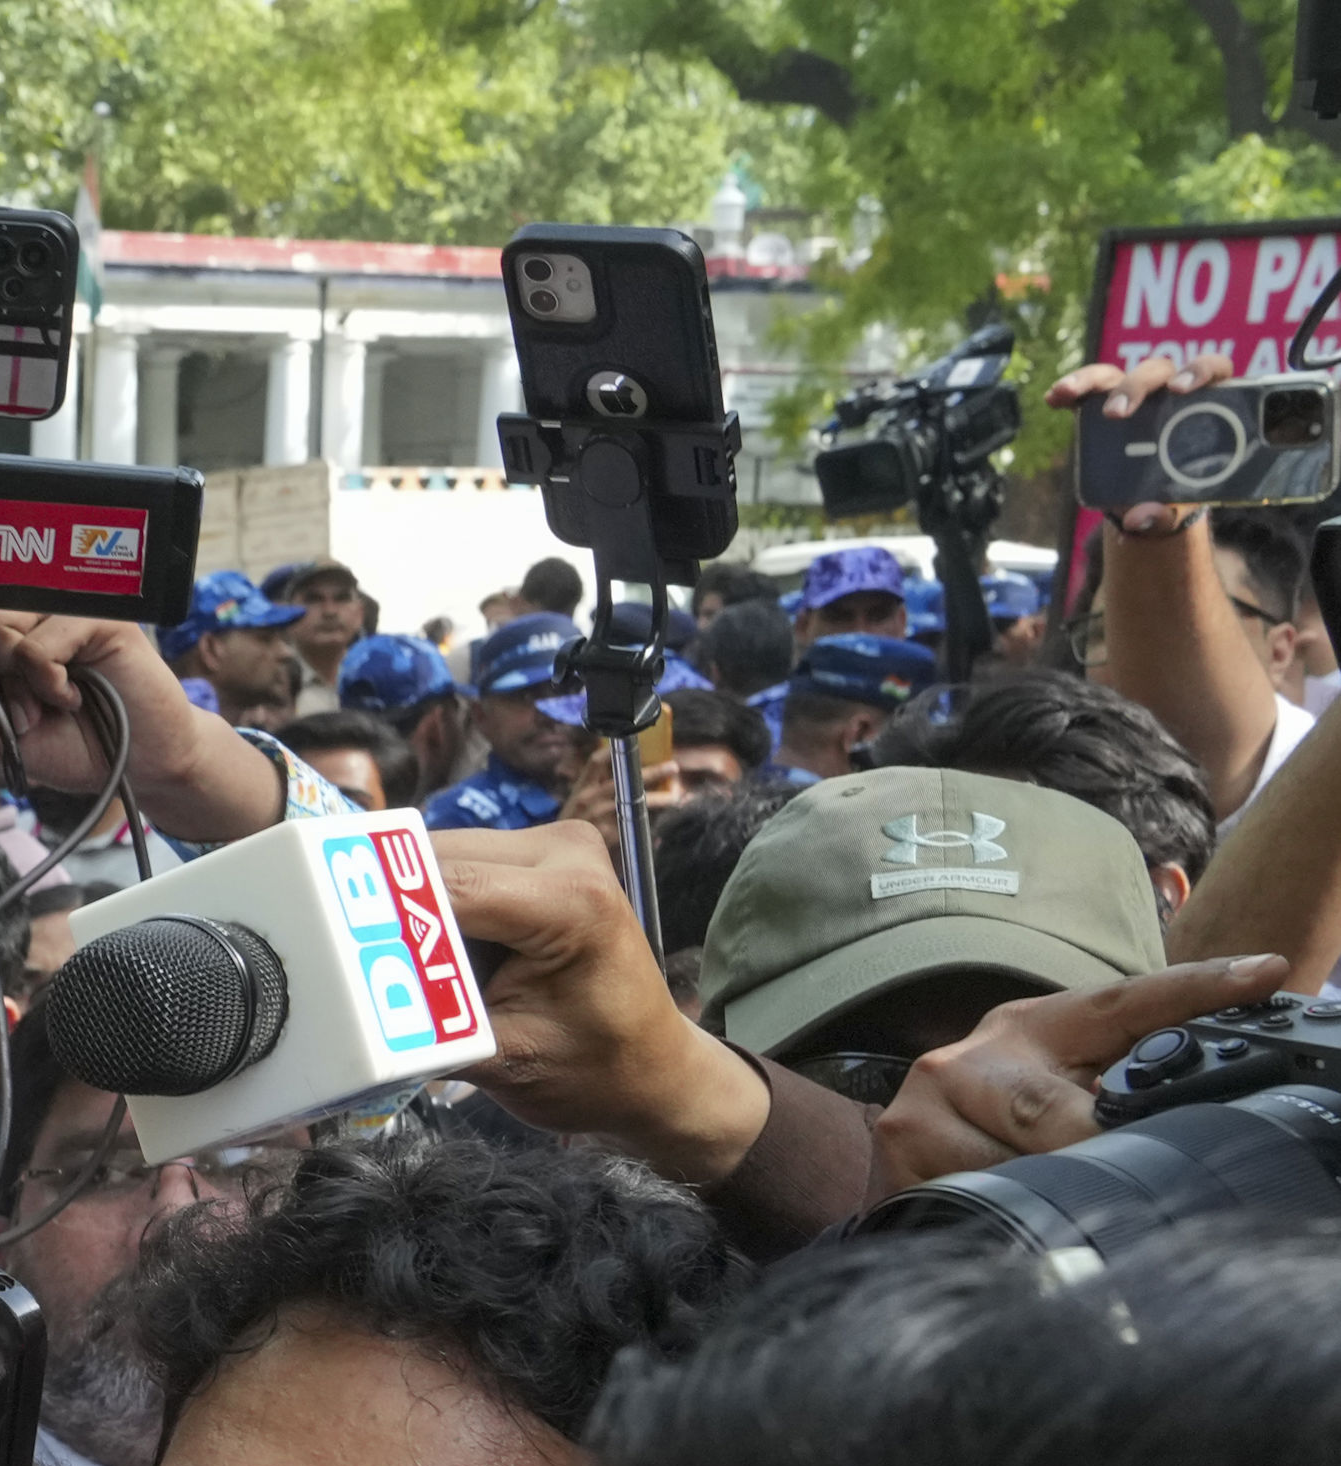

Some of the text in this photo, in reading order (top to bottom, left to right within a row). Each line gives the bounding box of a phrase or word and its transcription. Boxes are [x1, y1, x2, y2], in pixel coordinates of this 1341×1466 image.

[1122, 239, 1230, 329] NO
[328, 836, 434, 1044] DB
[387, 832, 473, 1036] LIVE
[877, 874, 936, 891] UNDER
[937, 872, 1010, 887] ARMOUR
